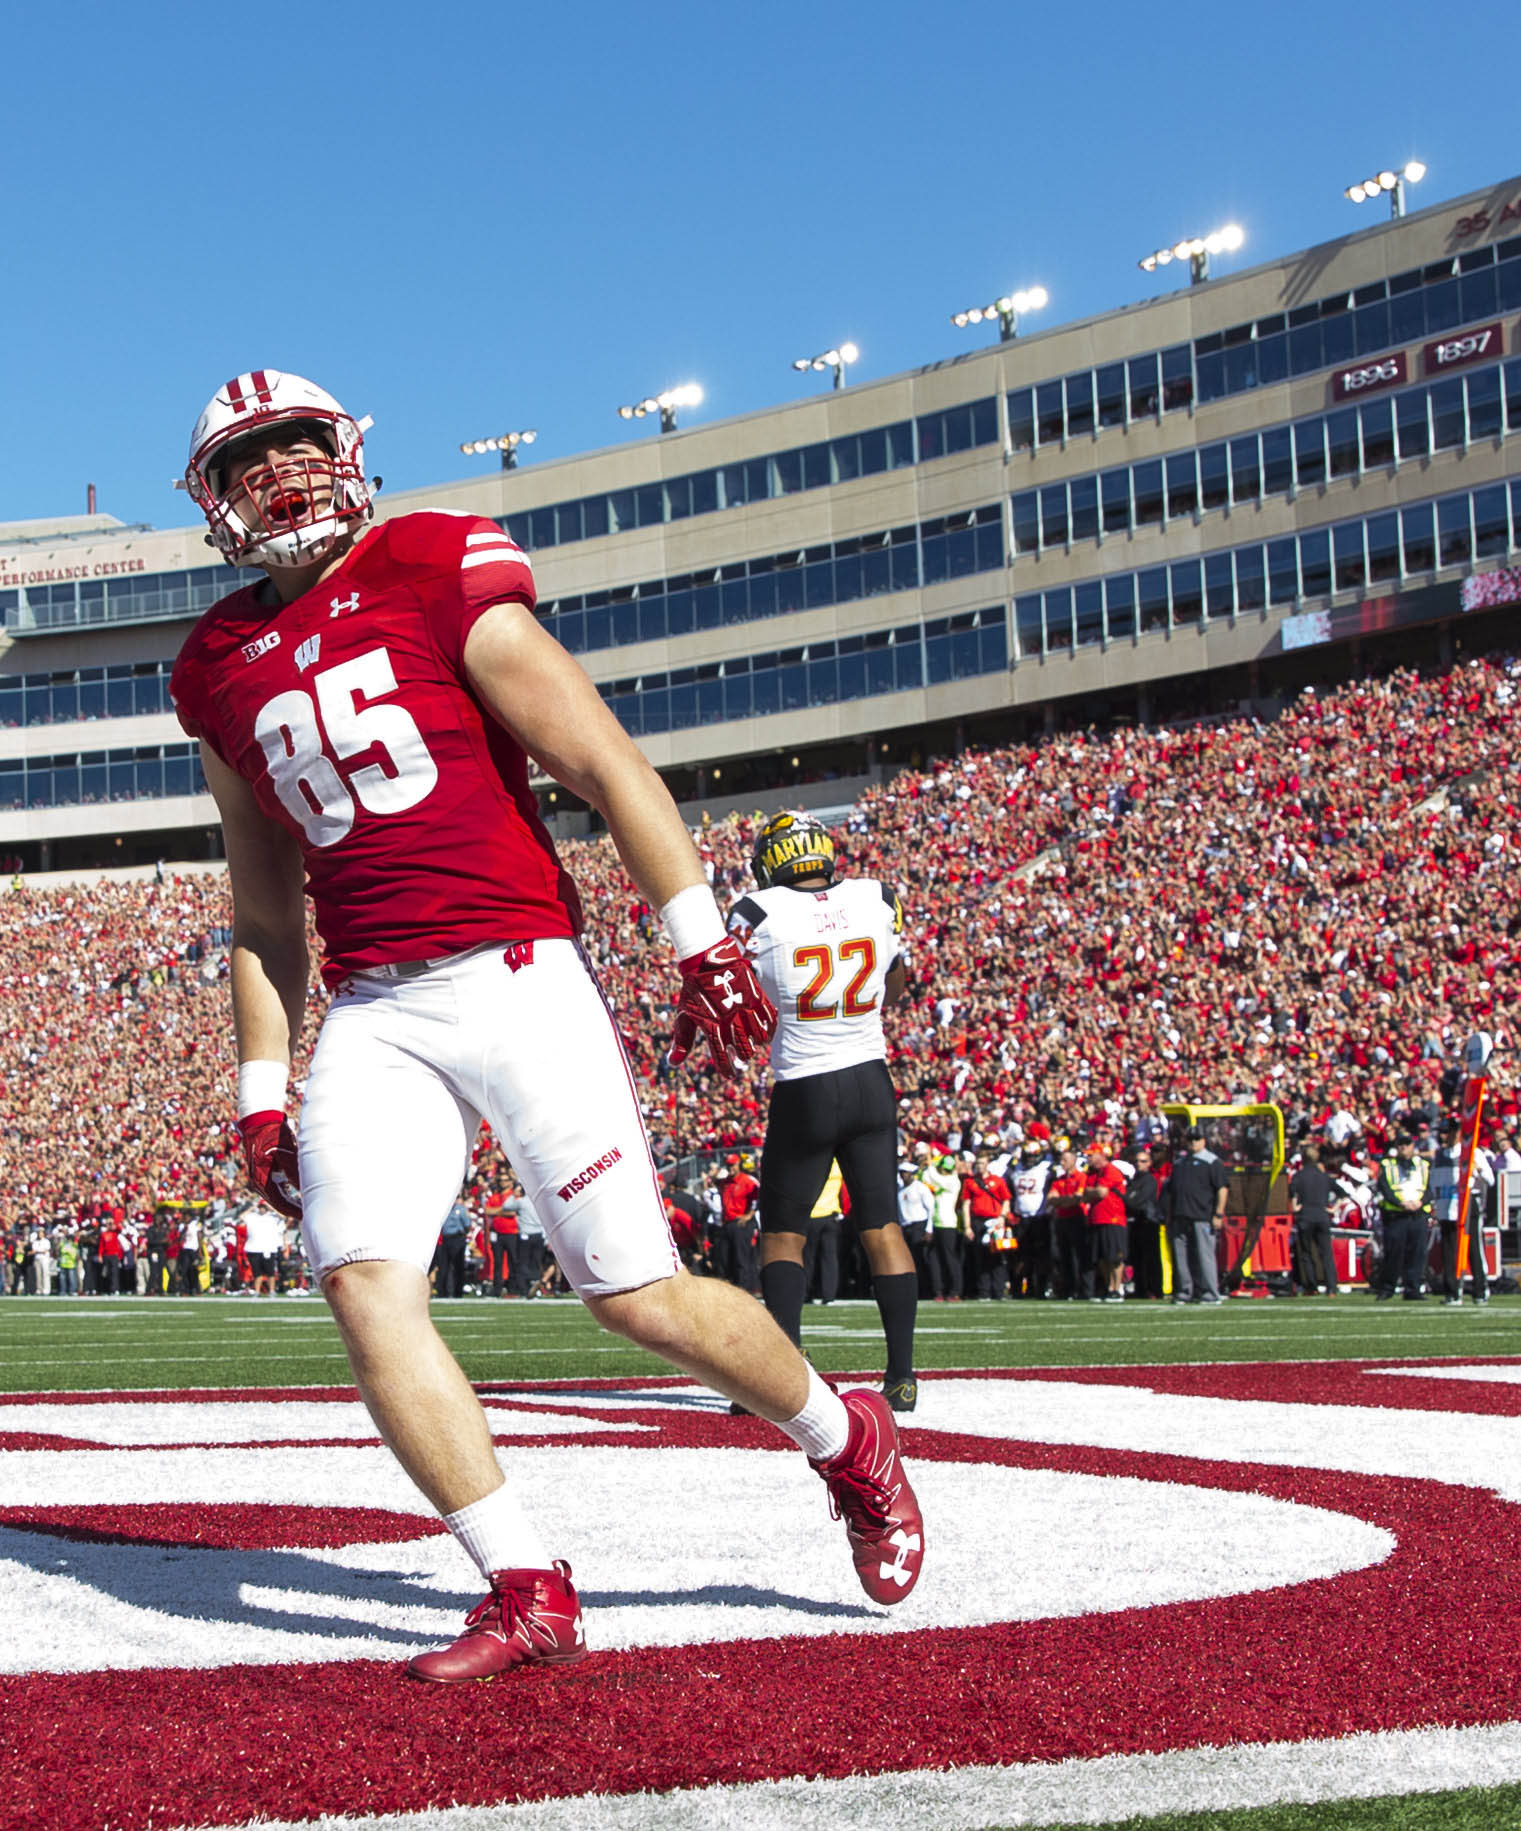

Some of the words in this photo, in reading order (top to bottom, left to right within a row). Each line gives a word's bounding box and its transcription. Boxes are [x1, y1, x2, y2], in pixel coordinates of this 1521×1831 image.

[1436, 330, 1492, 364] 1897
[1342, 359, 1398, 392] 1896
[94, 558, 145, 577] CENTER
[294, 633, 321, 673] W
[255, 647, 438, 847] 85
[761, 831, 834, 876] MARYLAN
[814, 908, 849, 934] DAVIS
[793, 936, 879, 1021] 22
[557, 1147, 623, 1203] WISCONSIN
